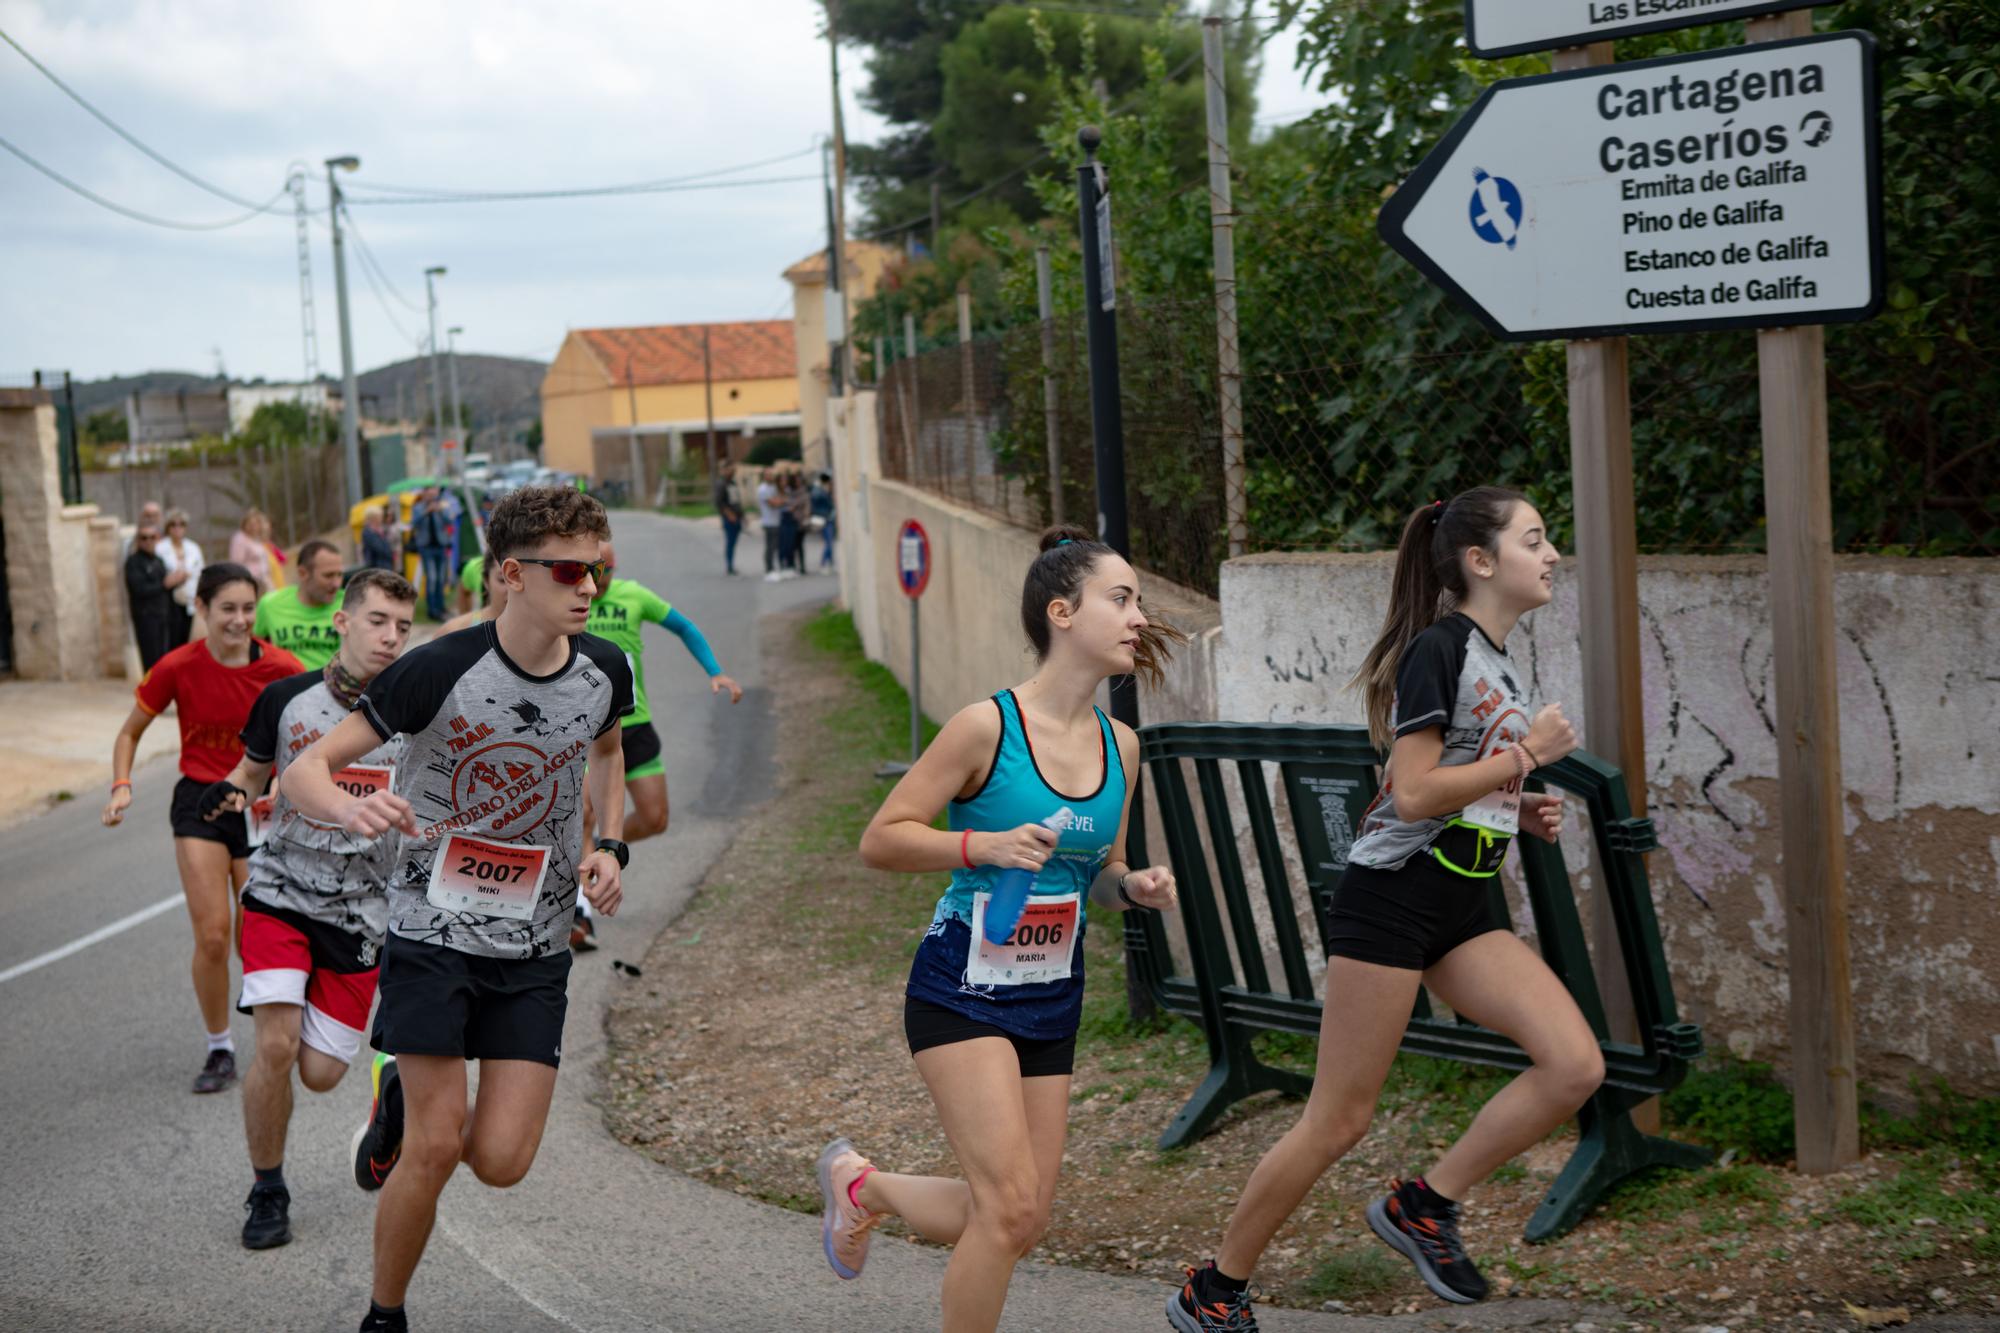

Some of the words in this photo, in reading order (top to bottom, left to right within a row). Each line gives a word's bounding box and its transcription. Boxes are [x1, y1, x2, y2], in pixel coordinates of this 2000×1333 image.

[1589, 3, 1628, 24] Las
[1597, 64, 1825, 120] Cartagena
[1600, 118, 1788, 173] Caseríos
[1621, 174, 1694, 200] Ermita
[1700, 170, 1729, 192] de
[1736, 160, 1806, 188] Galifa
[1623, 211, 1672, 234] Pino
[1679, 208, 1707, 229] de
[1713, 199, 1783, 226] Galifa
[1624, 249, 1715, 272] Estanco
[1722, 242, 1750, 265] de
[1757, 235, 1829, 262] Galifa
[1626, 285, 1704, 309] Cuesta
[1711, 282, 1740, 303] de
[1746, 276, 1817, 301] Galifa
[275, 624, 340, 641] UCAM
[447, 722, 496, 754] TRAIL
[449, 715, 469, 734] III
[423, 795, 506, 842] SENDERO
[504, 772, 542, 801] DEL
[543, 740, 586, 778] AGUA
[491, 792, 545, 831] GALIFA
[457, 856, 527, 883] 2007
[477, 886, 500, 895] MIKI
[1016, 954, 1046, 963] MARIA
